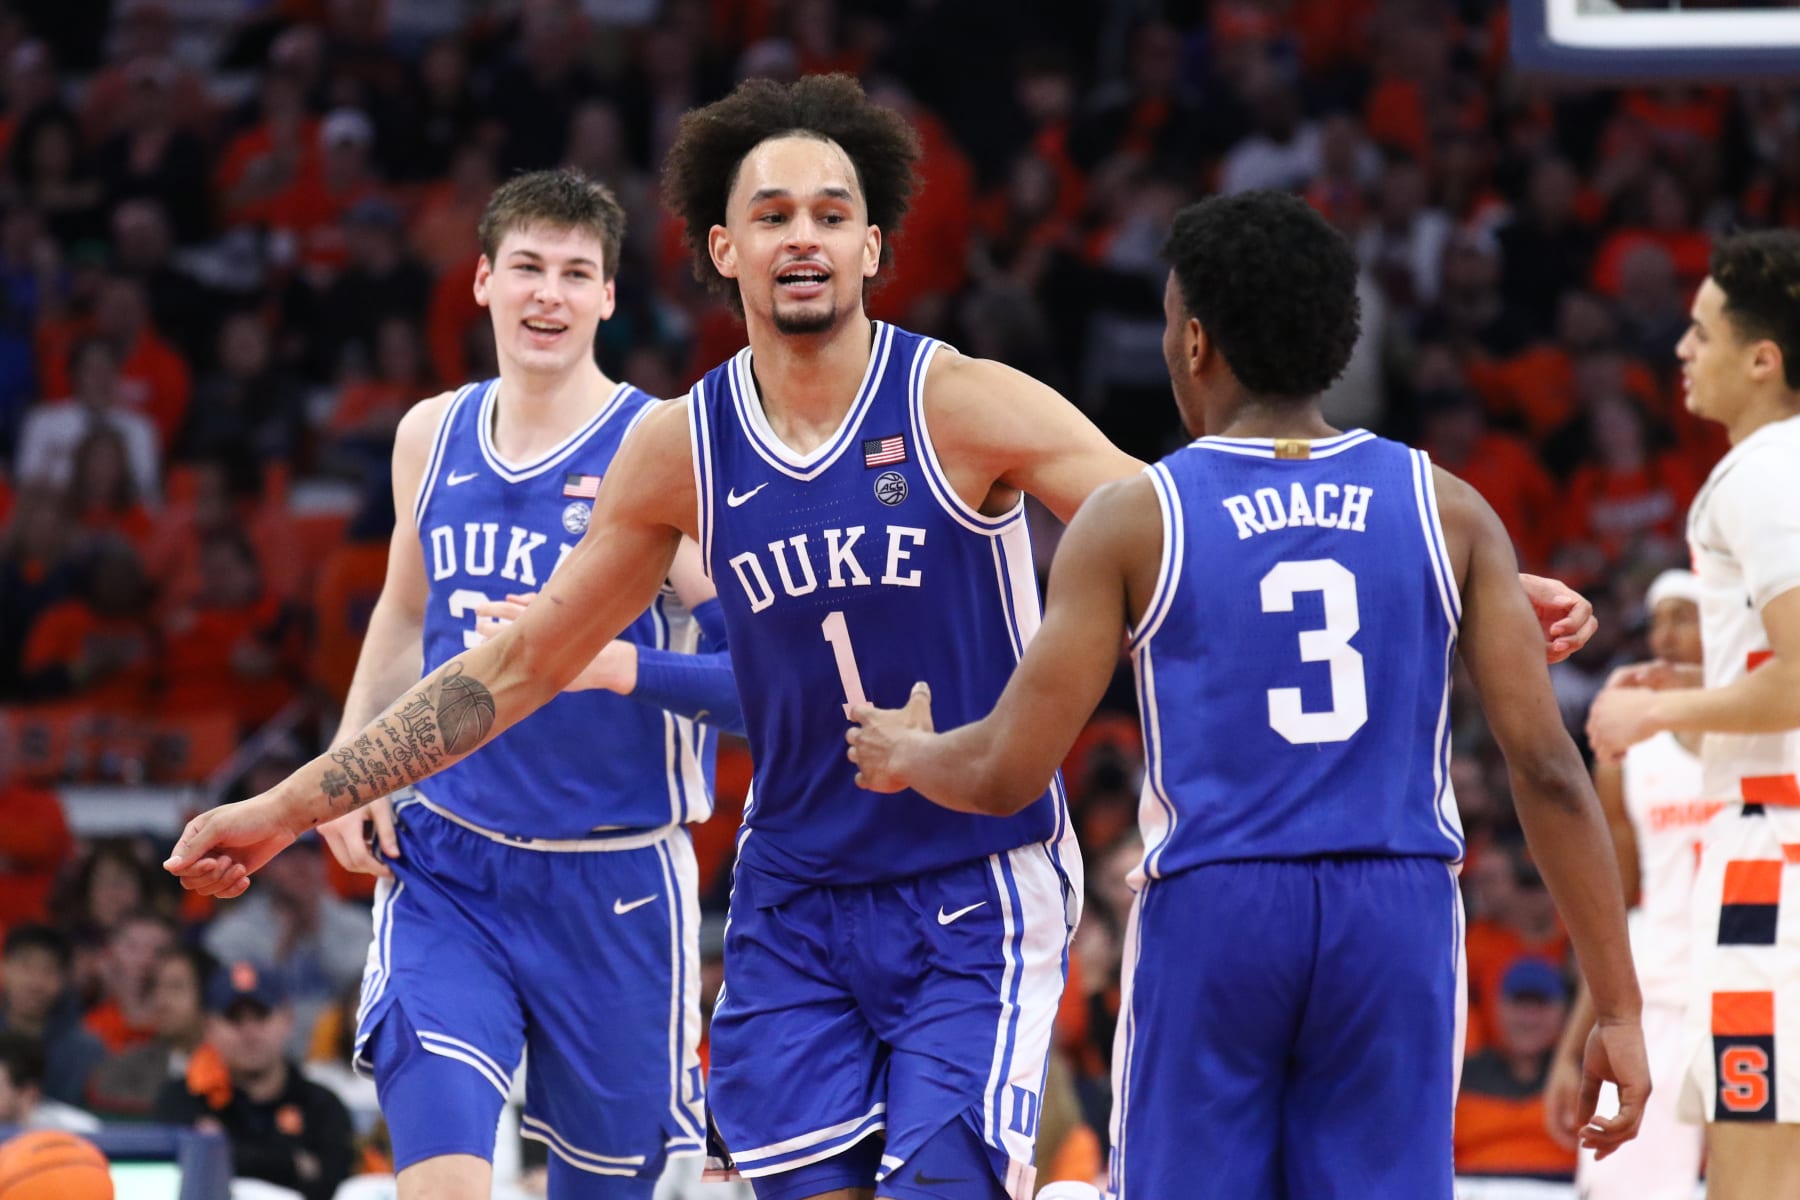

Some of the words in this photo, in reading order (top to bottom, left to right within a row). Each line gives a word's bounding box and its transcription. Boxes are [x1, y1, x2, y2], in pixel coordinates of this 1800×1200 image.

[1222, 482, 1374, 541] ROACH
[728, 525, 927, 614] DUKE
[821, 611, 875, 721] 1
[1259, 558, 1369, 745] 3
[394, 691, 437, 749] Life
[1007, 1083, 1037, 1138] D
[1720, 1046, 1769, 1112] S
